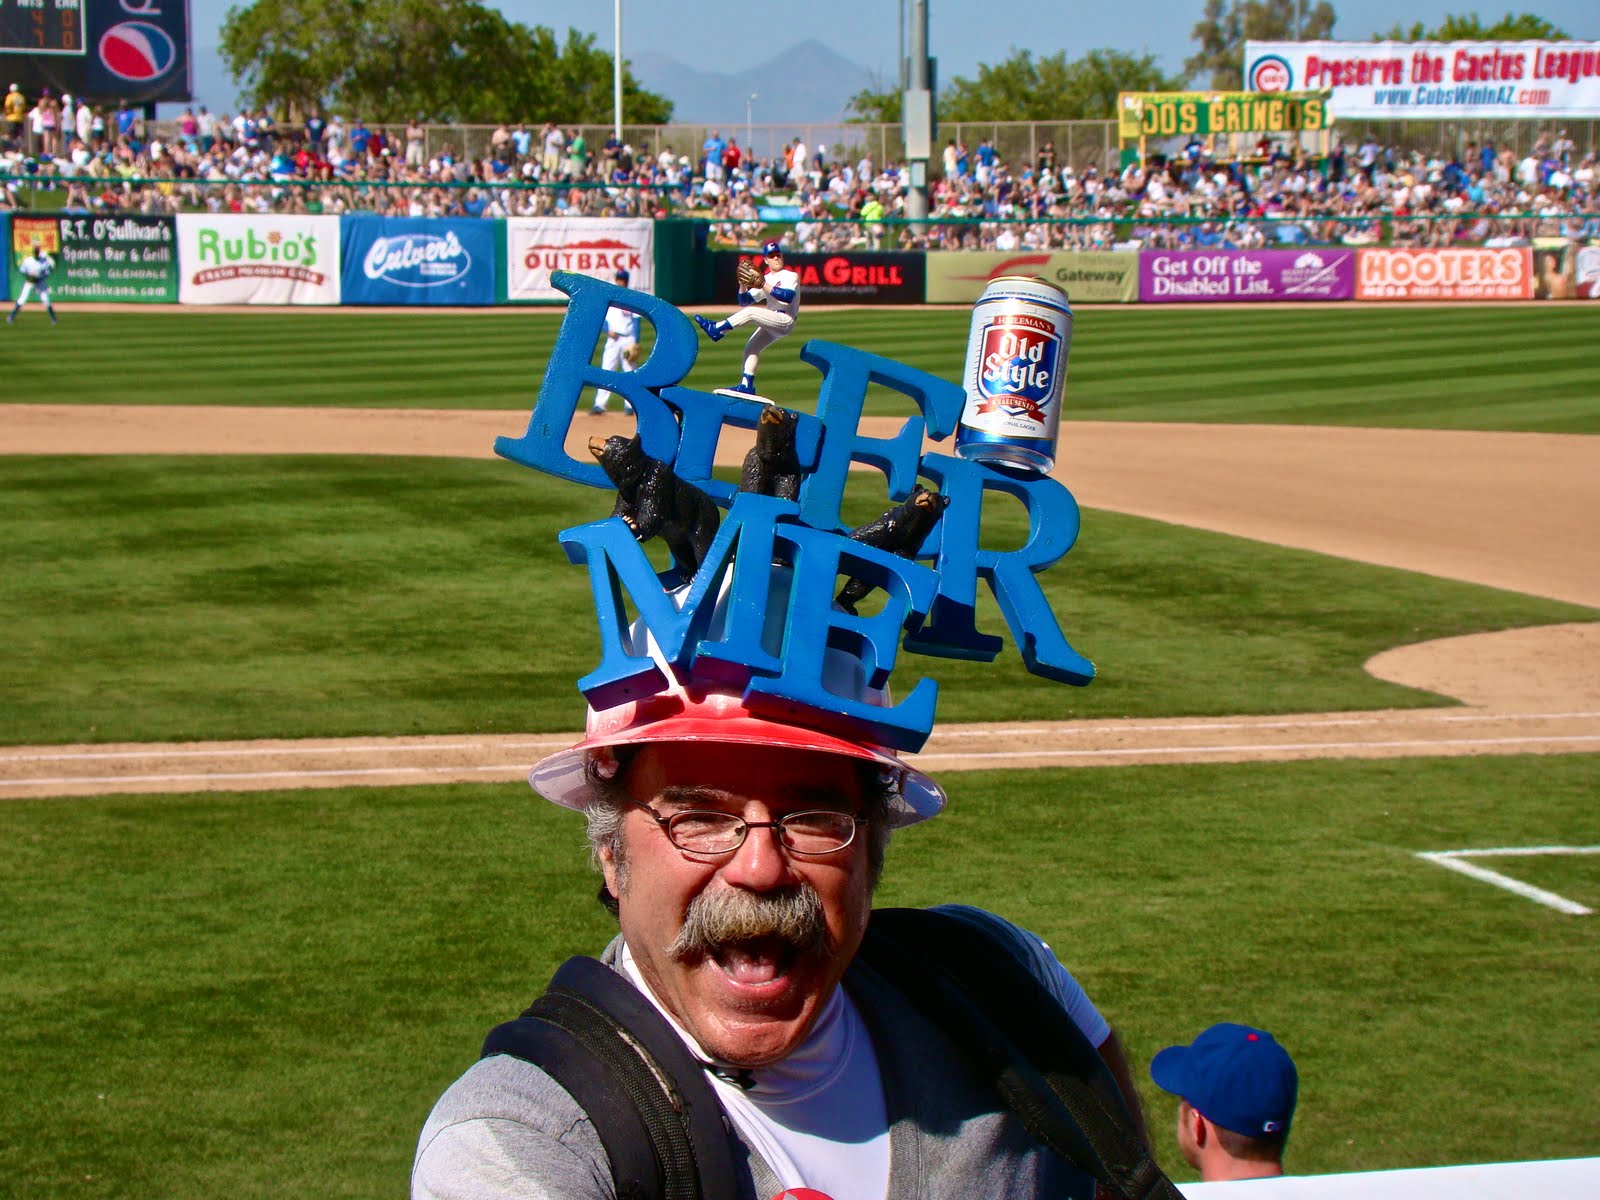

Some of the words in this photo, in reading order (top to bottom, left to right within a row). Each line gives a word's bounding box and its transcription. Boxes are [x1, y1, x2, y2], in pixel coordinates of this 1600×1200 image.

[1304, 55, 1404, 88] Preserve
[1411, 50, 1443, 83] the
[1453, 48, 1525, 82] Cactus
[1374, 85, 1551, 105] www.CubsWinInAZ.com
[1209, 99, 1322, 132] GRINGOS
[60, 219, 90, 241] R.T.
[94, 219, 171, 241] O'Sullivan's
[63, 246, 100, 264] Sports
[104, 247, 125, 261] Bar
[142, 247, 169, 261] Grill
[197, 228, 317, 266] Rubio's
[364, 230, 462, 279] Culver's
[524, 253, 641, 270] OUTBACK
[823, 257, 903, 285] GRILL
[1056, 268, 1125, 285] Gateway
[1152, 256, 1188, 275] Get
[1192, 256, 1230, 275] Off
[1232, 256, 1262, 275] the
[1361, 249, 1522, 286] HOOTERS
[1153, 277, 1229, 295] Disabled
[1234, 277, 1275, 295] List.
[999, 332, 1045, 363] Old
[983, 352, 1050, 392] Style
[559, 492, 939, 753] ME
